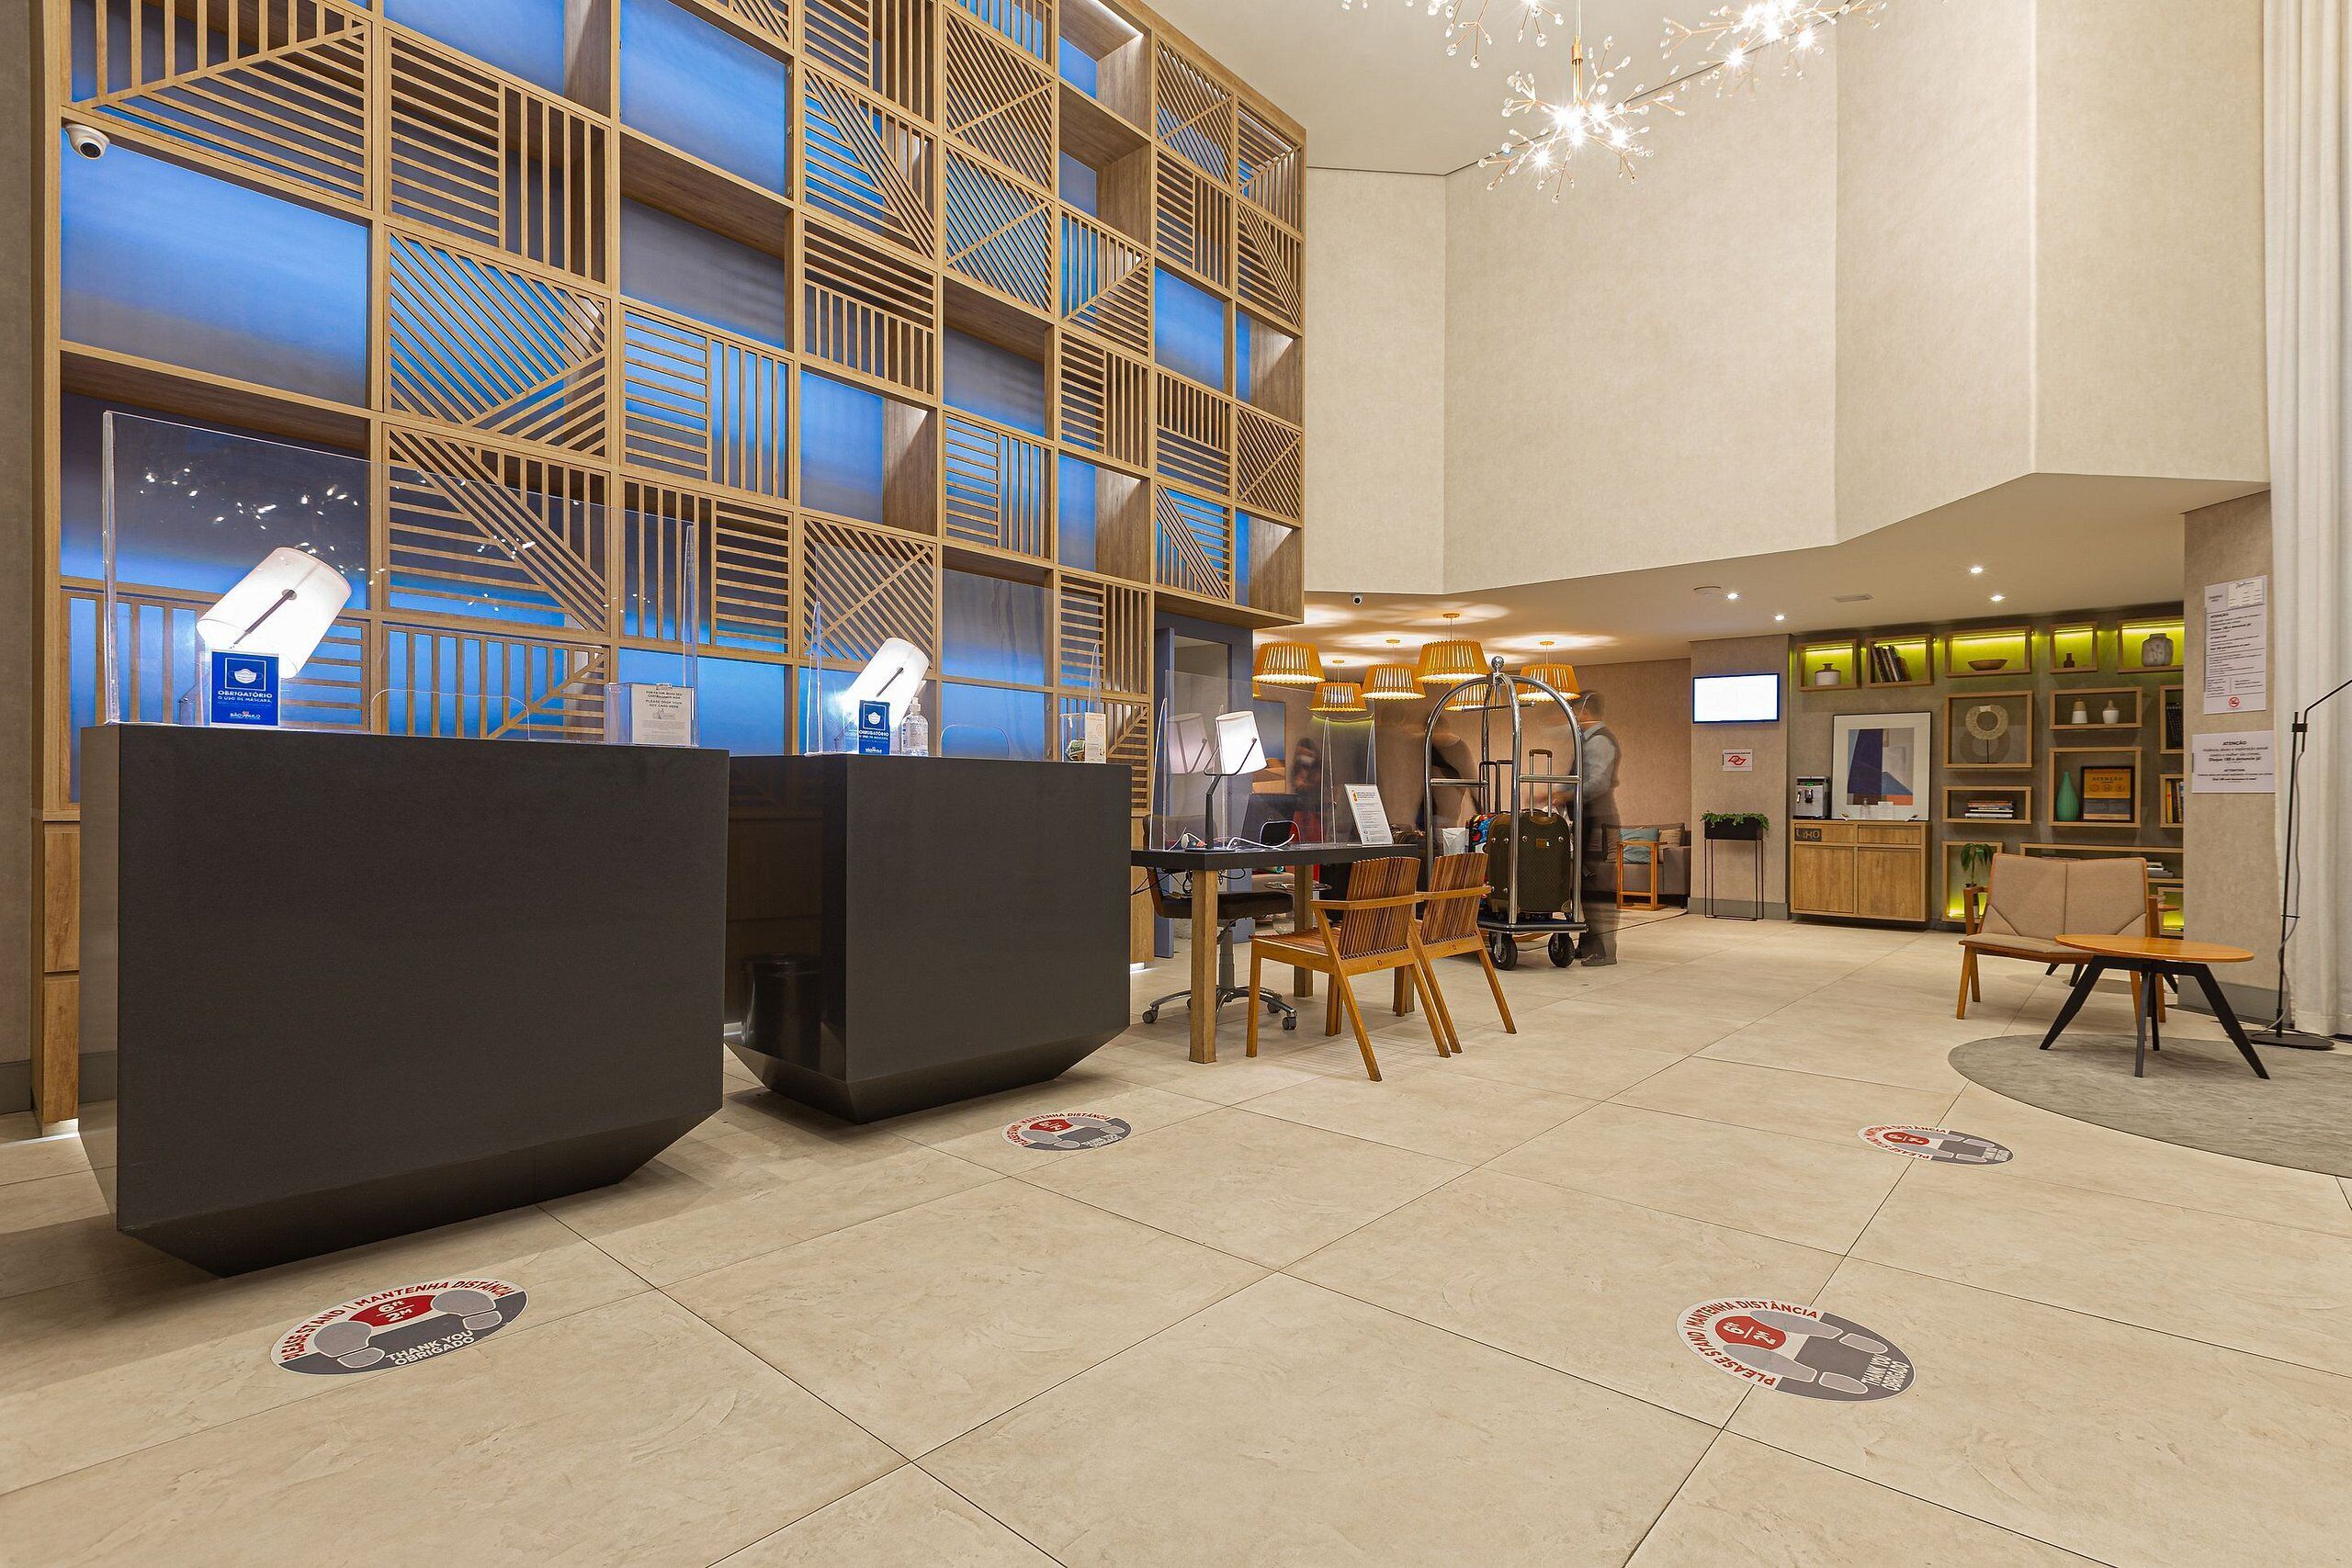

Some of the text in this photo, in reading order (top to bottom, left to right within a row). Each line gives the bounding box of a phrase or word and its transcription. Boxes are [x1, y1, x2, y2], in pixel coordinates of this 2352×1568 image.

[218, 690, 273, 698] OBRIGATÓRIO
[295, 1310, 345, 1334] STAND
[354, 1281, 449, 1307] MANTENHA
[451, 1280, 516, 1297] DISTÂNCIA
[386, 1330, 474, 1361] THANK YOU
[394, 1337, 475, 1365] OBRIGADO
[1685, 1300, 1817, 1386] PLEASE STAND MANTENHA DISTÂNCIA
[1860, 1353, 1892, 1387] THANK YOU
[1881, 1360, 1910, 1391] OBRIGADO
